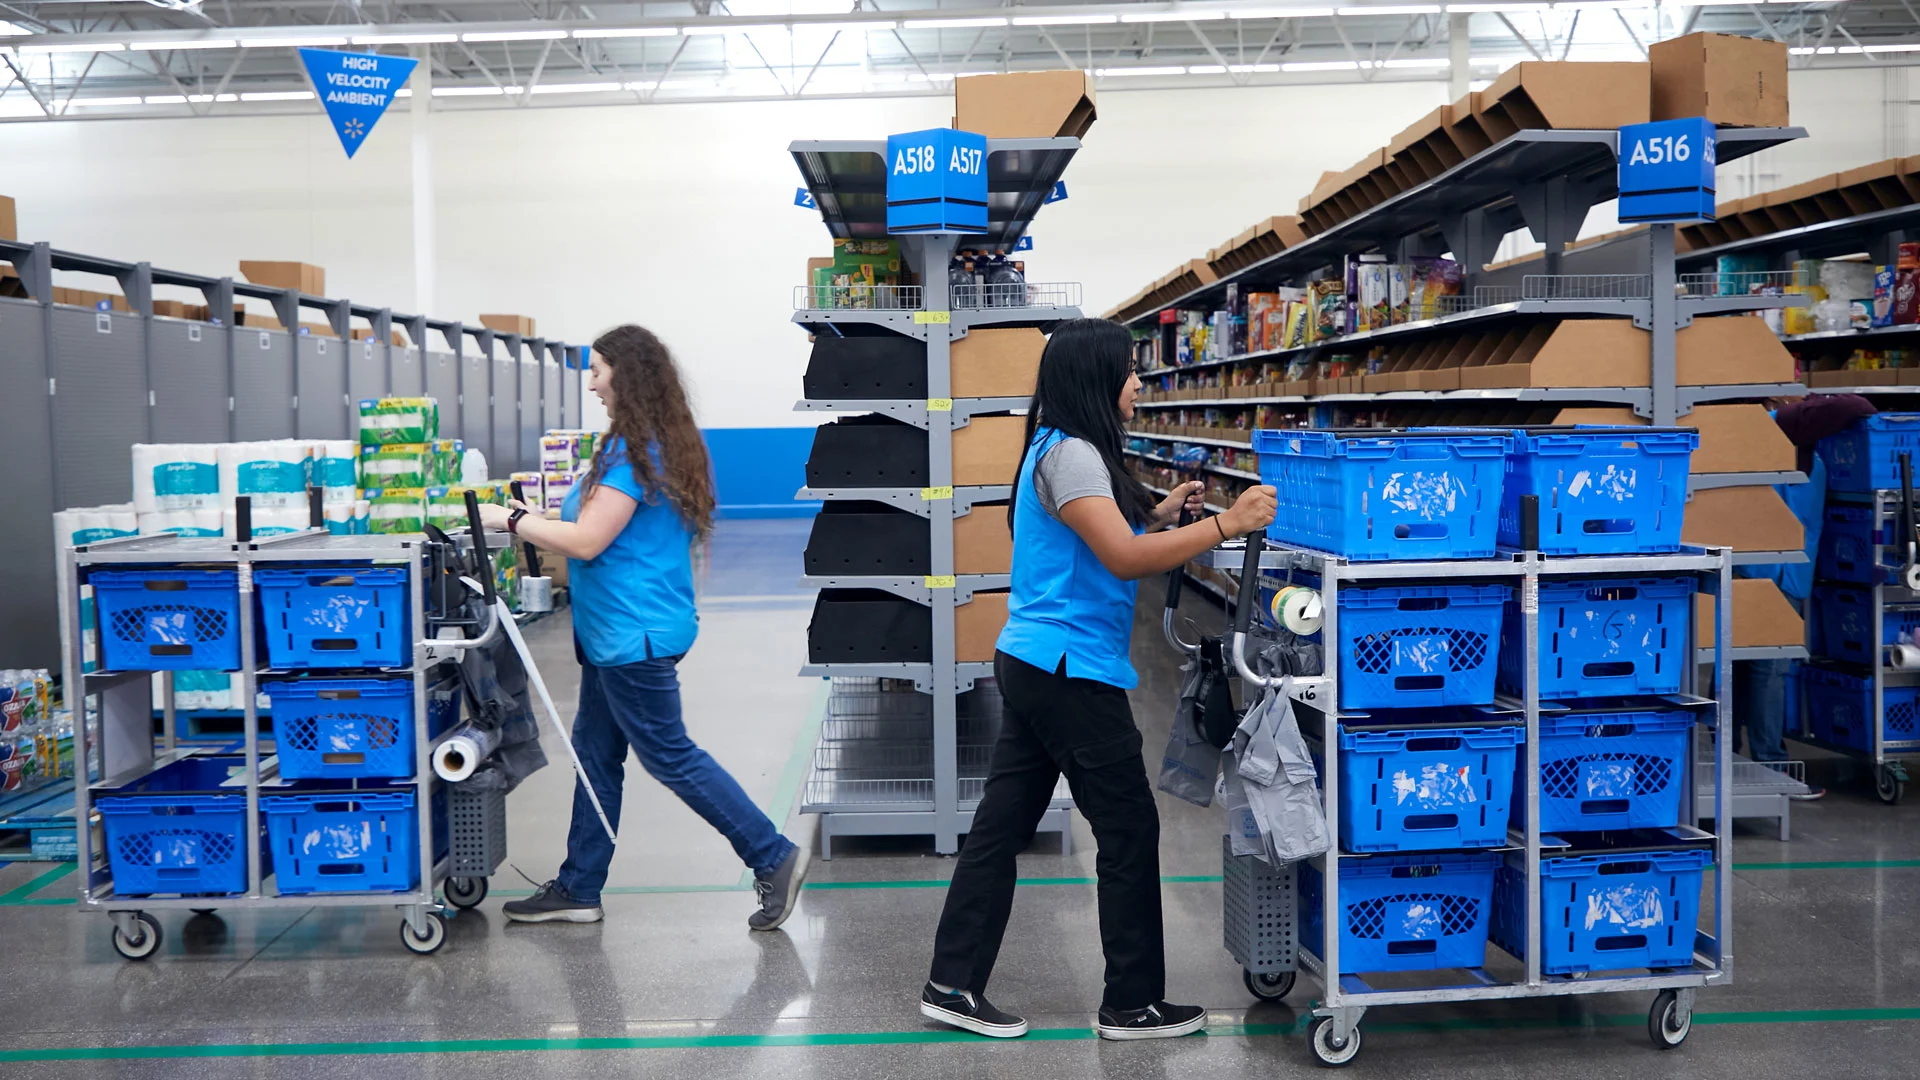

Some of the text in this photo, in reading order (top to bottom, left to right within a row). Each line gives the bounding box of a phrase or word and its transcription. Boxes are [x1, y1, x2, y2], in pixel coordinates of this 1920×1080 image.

[342, 56, 378, 71] HIGH
[326, 72, 391, 90] VELOCITY
[326, 90, 387, 106] AMBIENT
[1629, 134, 1690, 166] A516
[893, 145, 935, 176] A518
[949, 145, 982, 176] A517
[801, 192, 812, 205] 2
[1051, 186, 1059, 199] 2
[1019, 238, 1028, 249] 4
[426, 646, 438, 660] 2
[1300, 685, 1316, 701] 16
